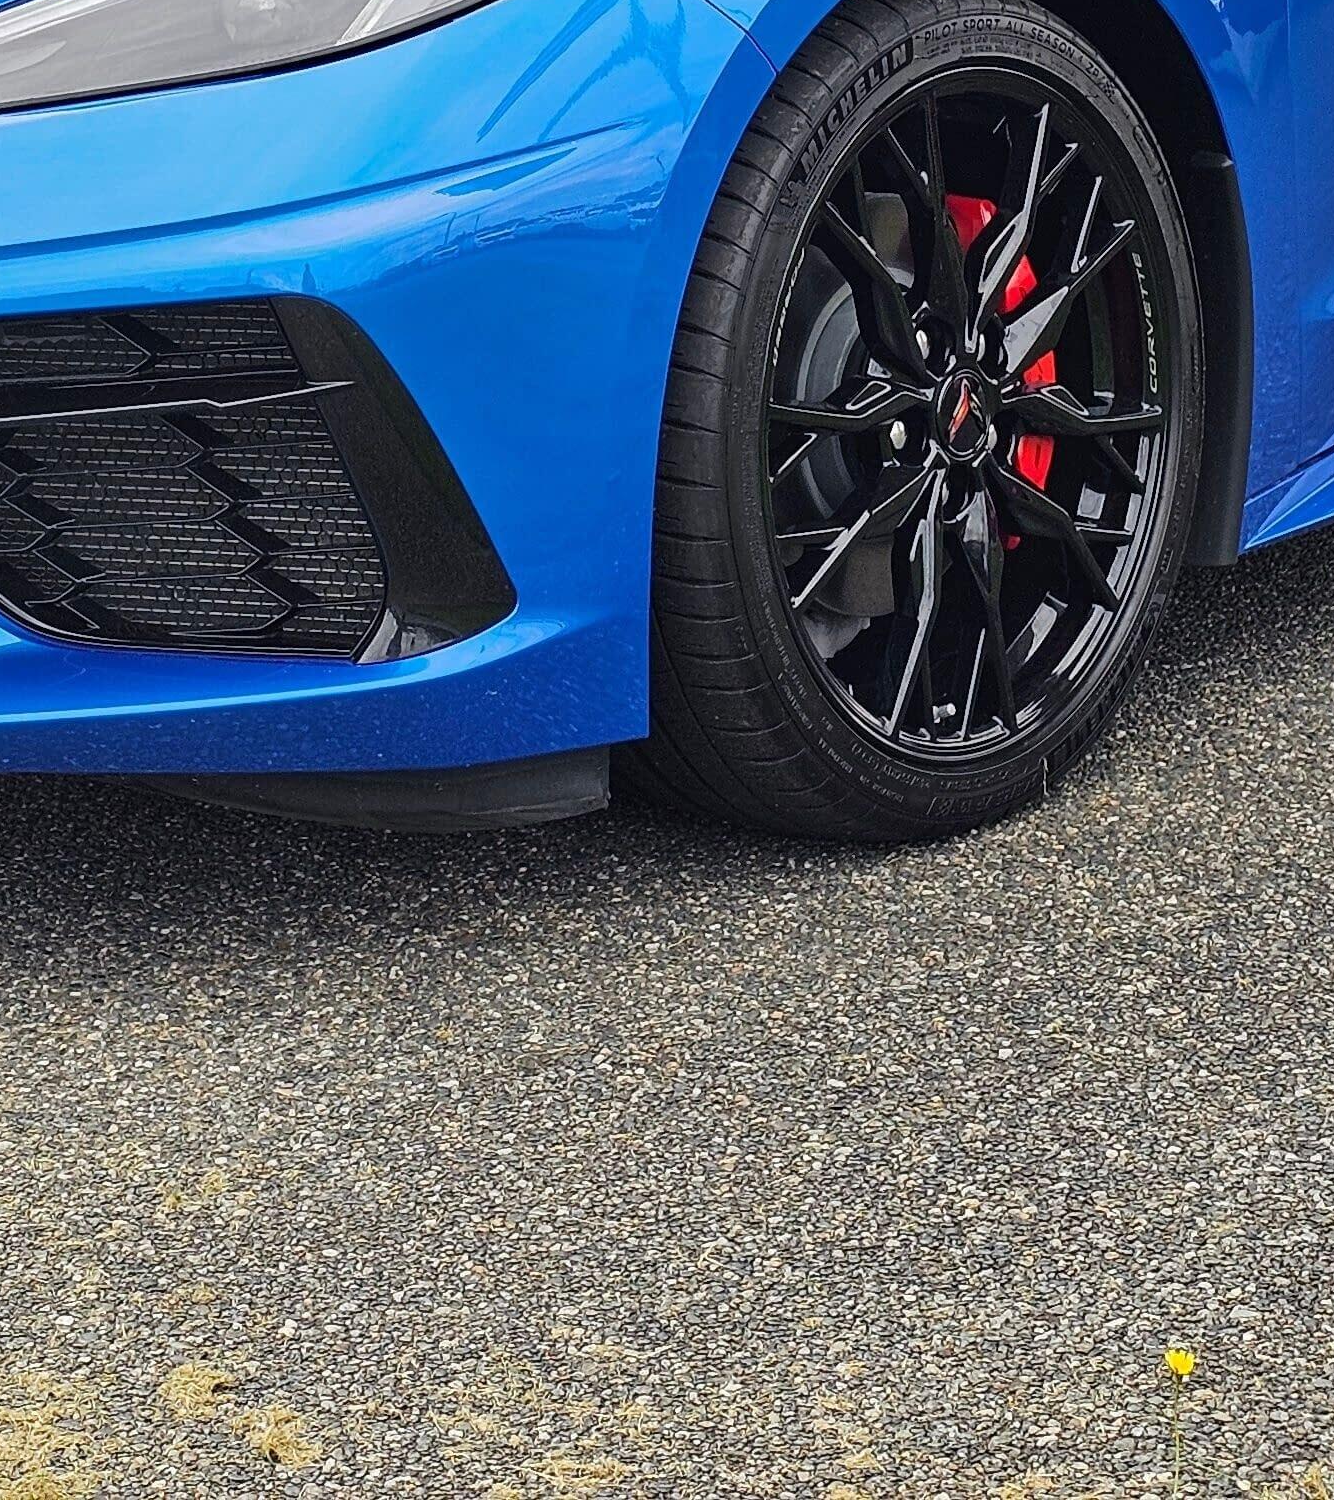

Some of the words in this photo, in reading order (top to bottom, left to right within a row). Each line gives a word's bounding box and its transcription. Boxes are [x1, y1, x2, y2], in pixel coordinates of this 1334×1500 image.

[924, 21, 958, 45] PILOT
[963, 18, 1001, 33] SPORT
[1005, 21, 1026, 37] ALL
[1030, 26, 1076, 59] SEASON
[800, 42, 908, 175] MICHELIN
[1131, 251, 1158, 394] CORVETTE
